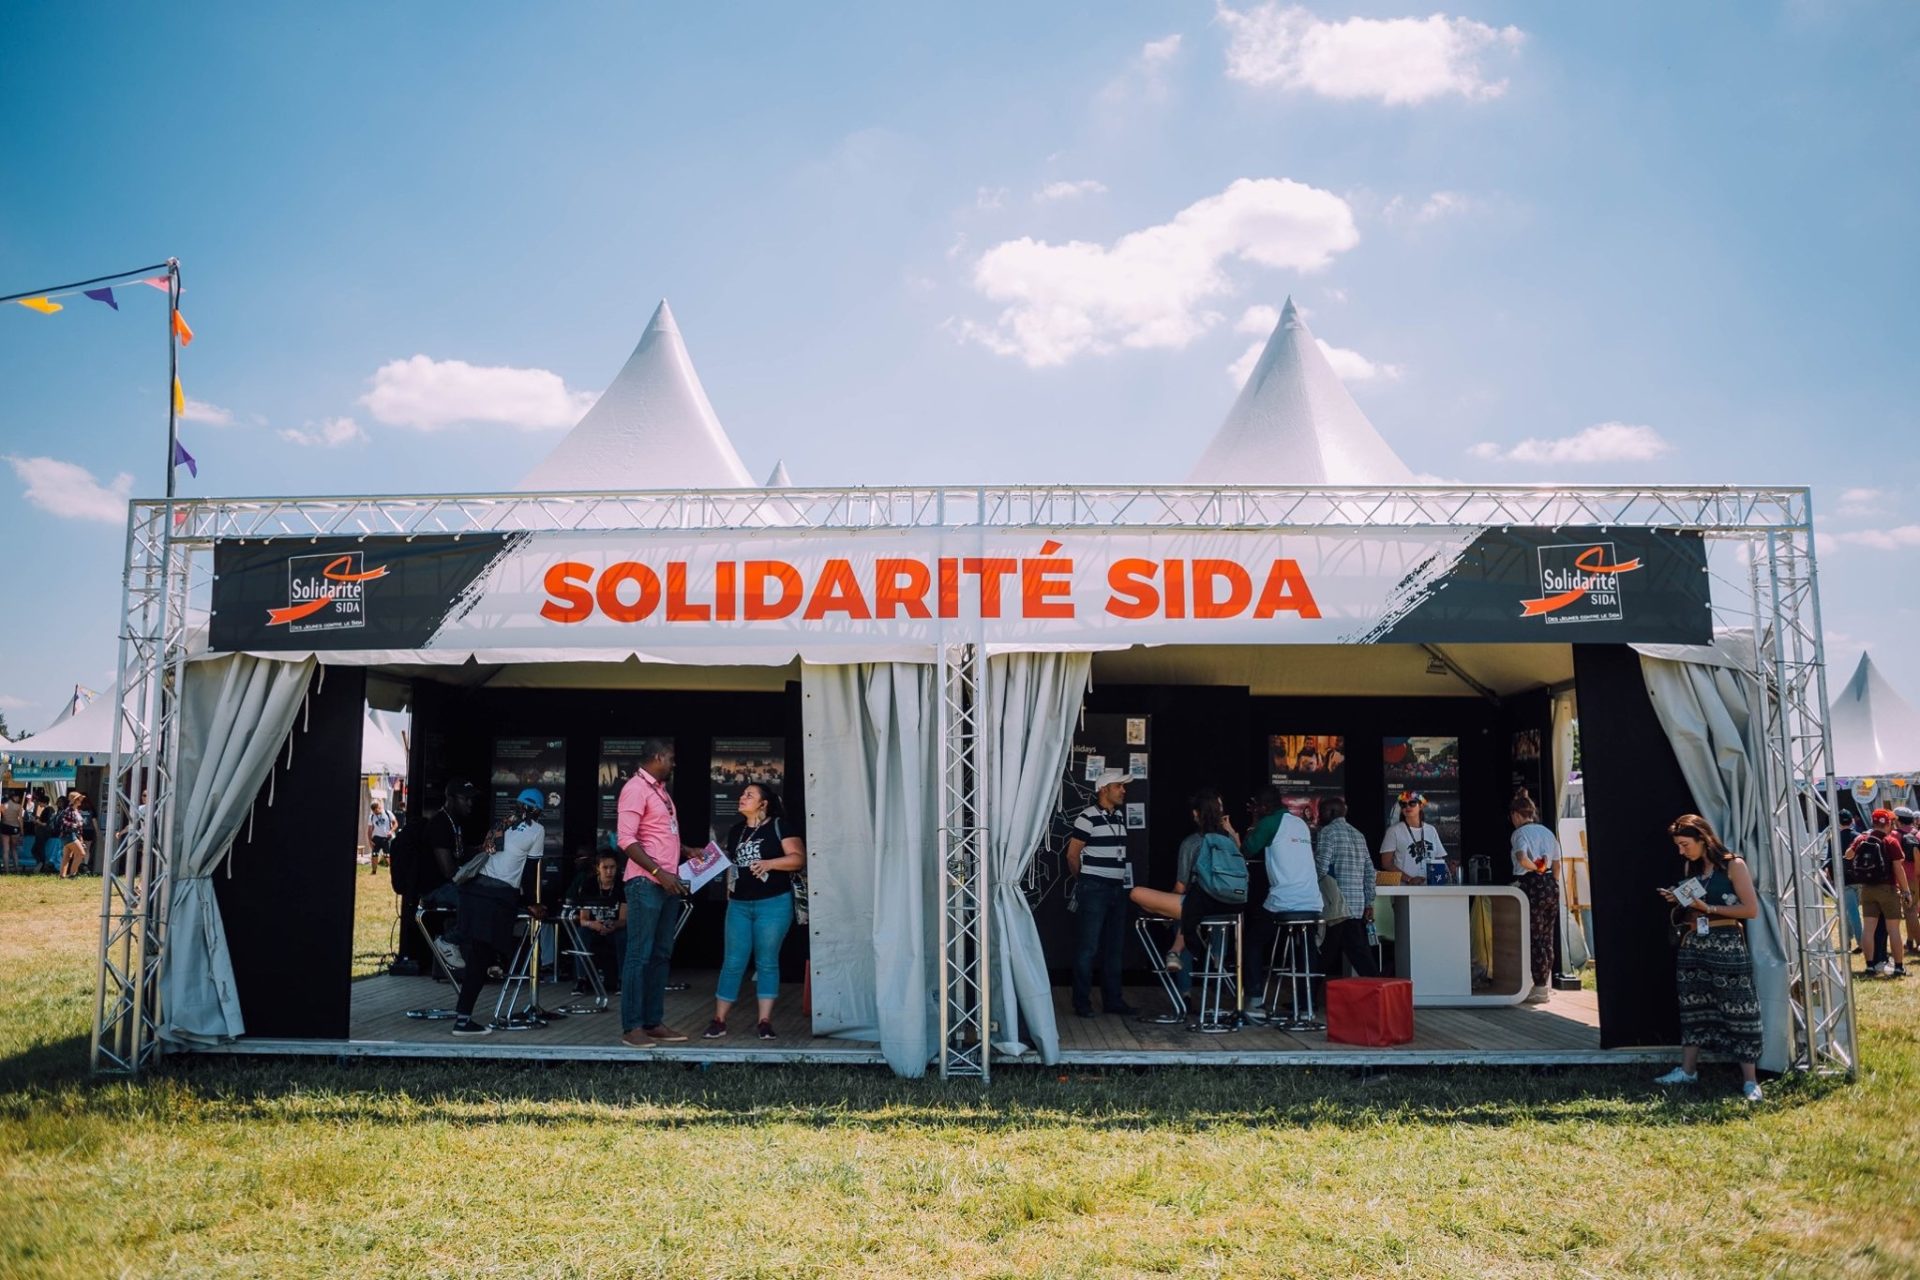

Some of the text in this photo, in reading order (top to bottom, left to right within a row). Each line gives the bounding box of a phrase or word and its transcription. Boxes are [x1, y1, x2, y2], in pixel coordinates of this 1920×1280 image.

[542, 540, 1320, 623] SOLIDARITÉ SIDA
[1544, 568, 1616, 590] Solidarité
[292, 577, 362, 599] Solidarité
[335, 602, 360, 613] SIDA
[1591, 594, 1616, 605] SIDA
[1072, 743, 1097, 754] olidays
